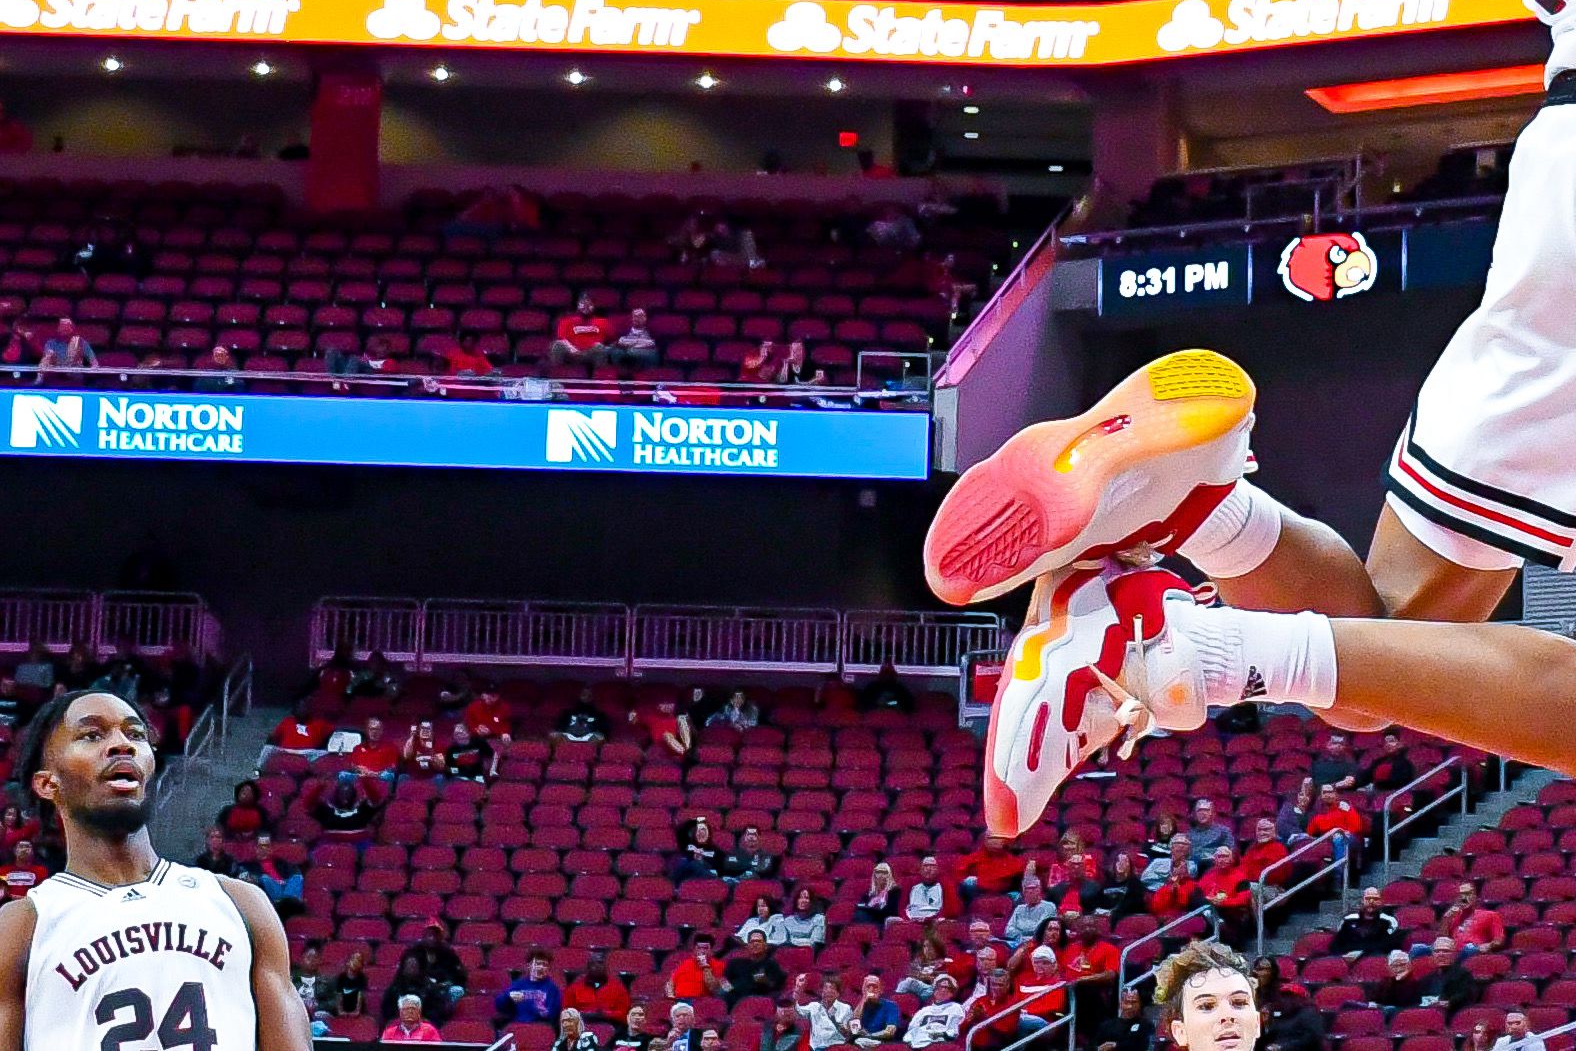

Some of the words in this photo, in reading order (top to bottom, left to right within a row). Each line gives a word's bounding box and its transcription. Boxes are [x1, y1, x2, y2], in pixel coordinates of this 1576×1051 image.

[1120, 267, 1175, 297] 8:31
[1185, 262, 1228, 292] PM
[97, 397, 244, 431] NORTON
[632, 412, 779, 445] NORTON
[98, 429, 244, 453] HEALTHCARE
[633, 444, 779, 467] HEALTHCARE
[55, 922, 233, 992] LOUISVILLE
[95, 982, 218, 1051] 24
